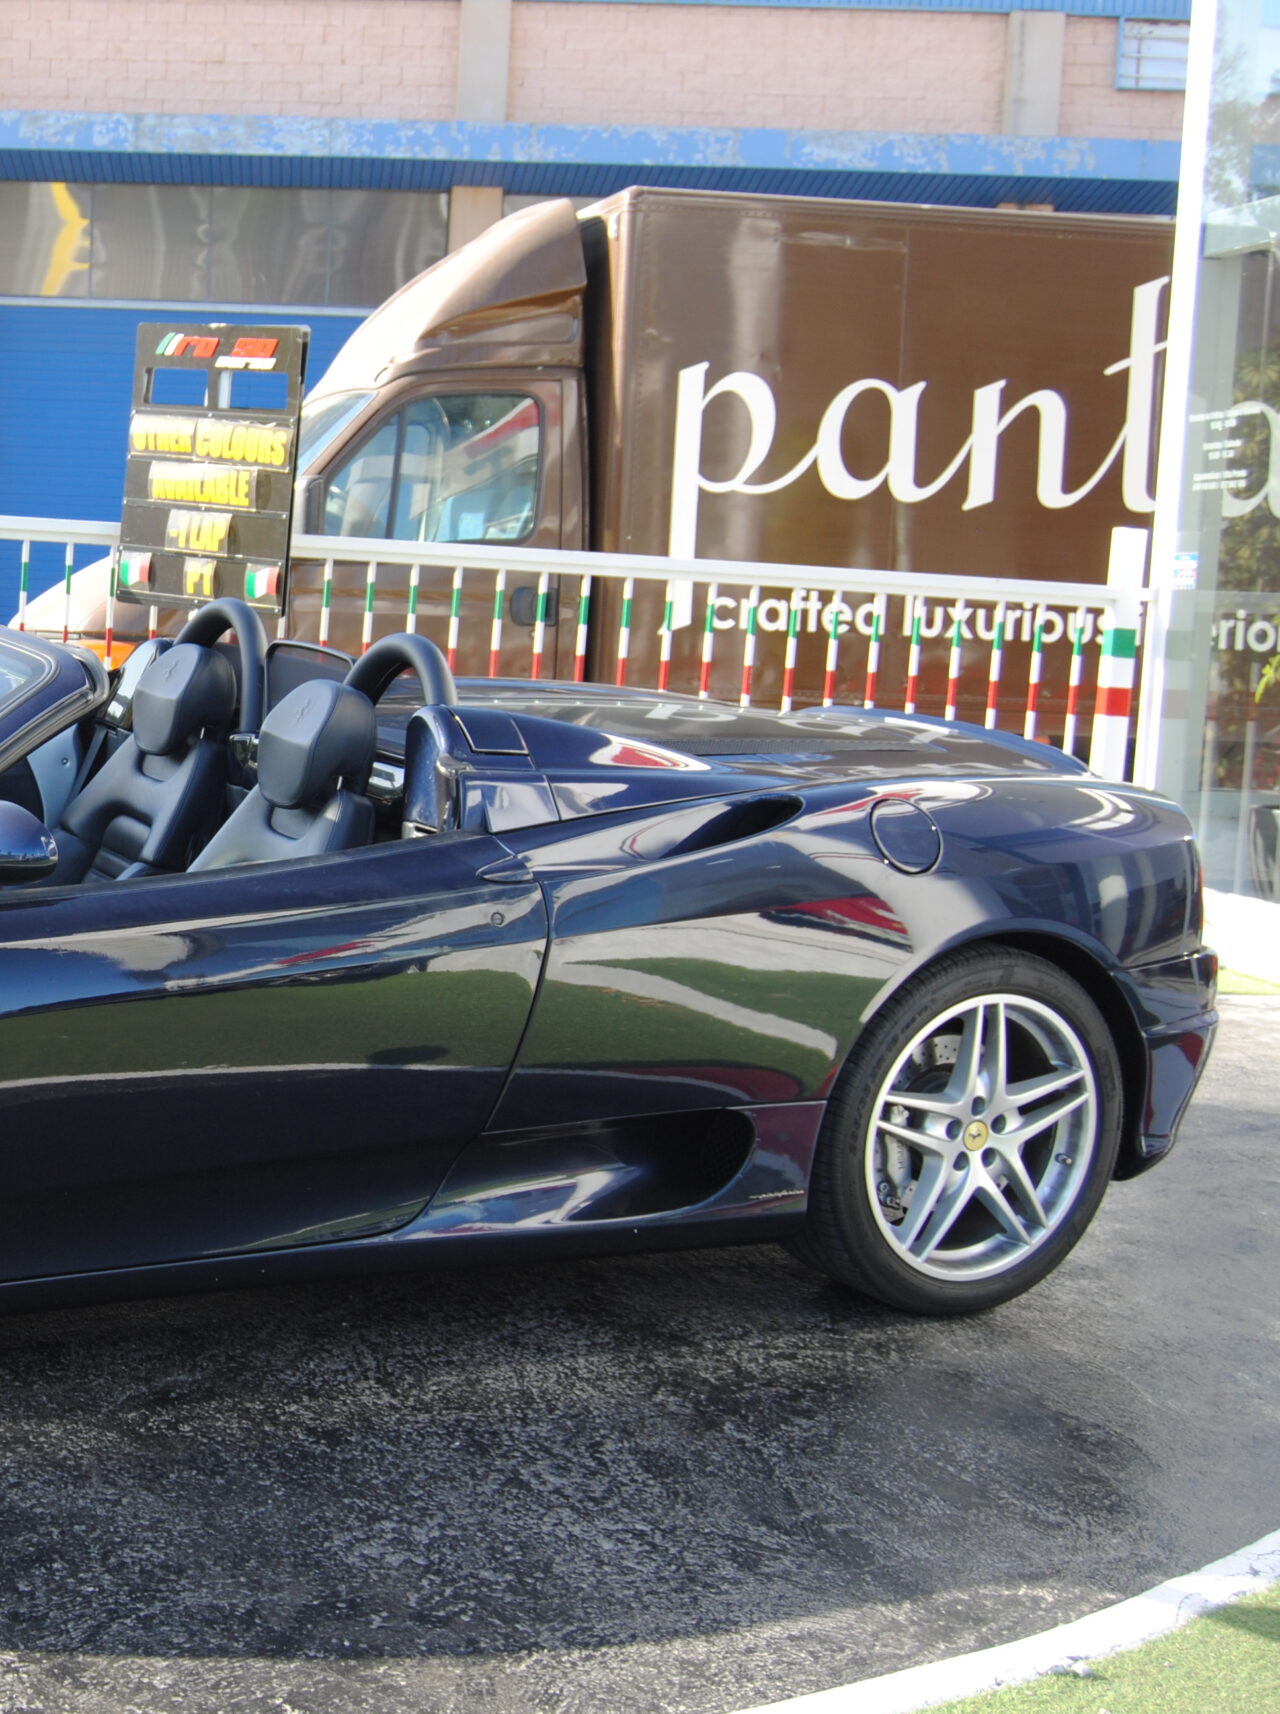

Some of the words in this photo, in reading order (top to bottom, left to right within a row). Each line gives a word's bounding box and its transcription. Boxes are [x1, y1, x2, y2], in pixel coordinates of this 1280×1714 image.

[195, 422, 288, 466] COLOURS
[151, 466, 250, 507] AVAILABLE
[189, 514, 228, 552] LAP
[186, 562, 214, 596] P1
[712, 588, 885, 636] crafted
